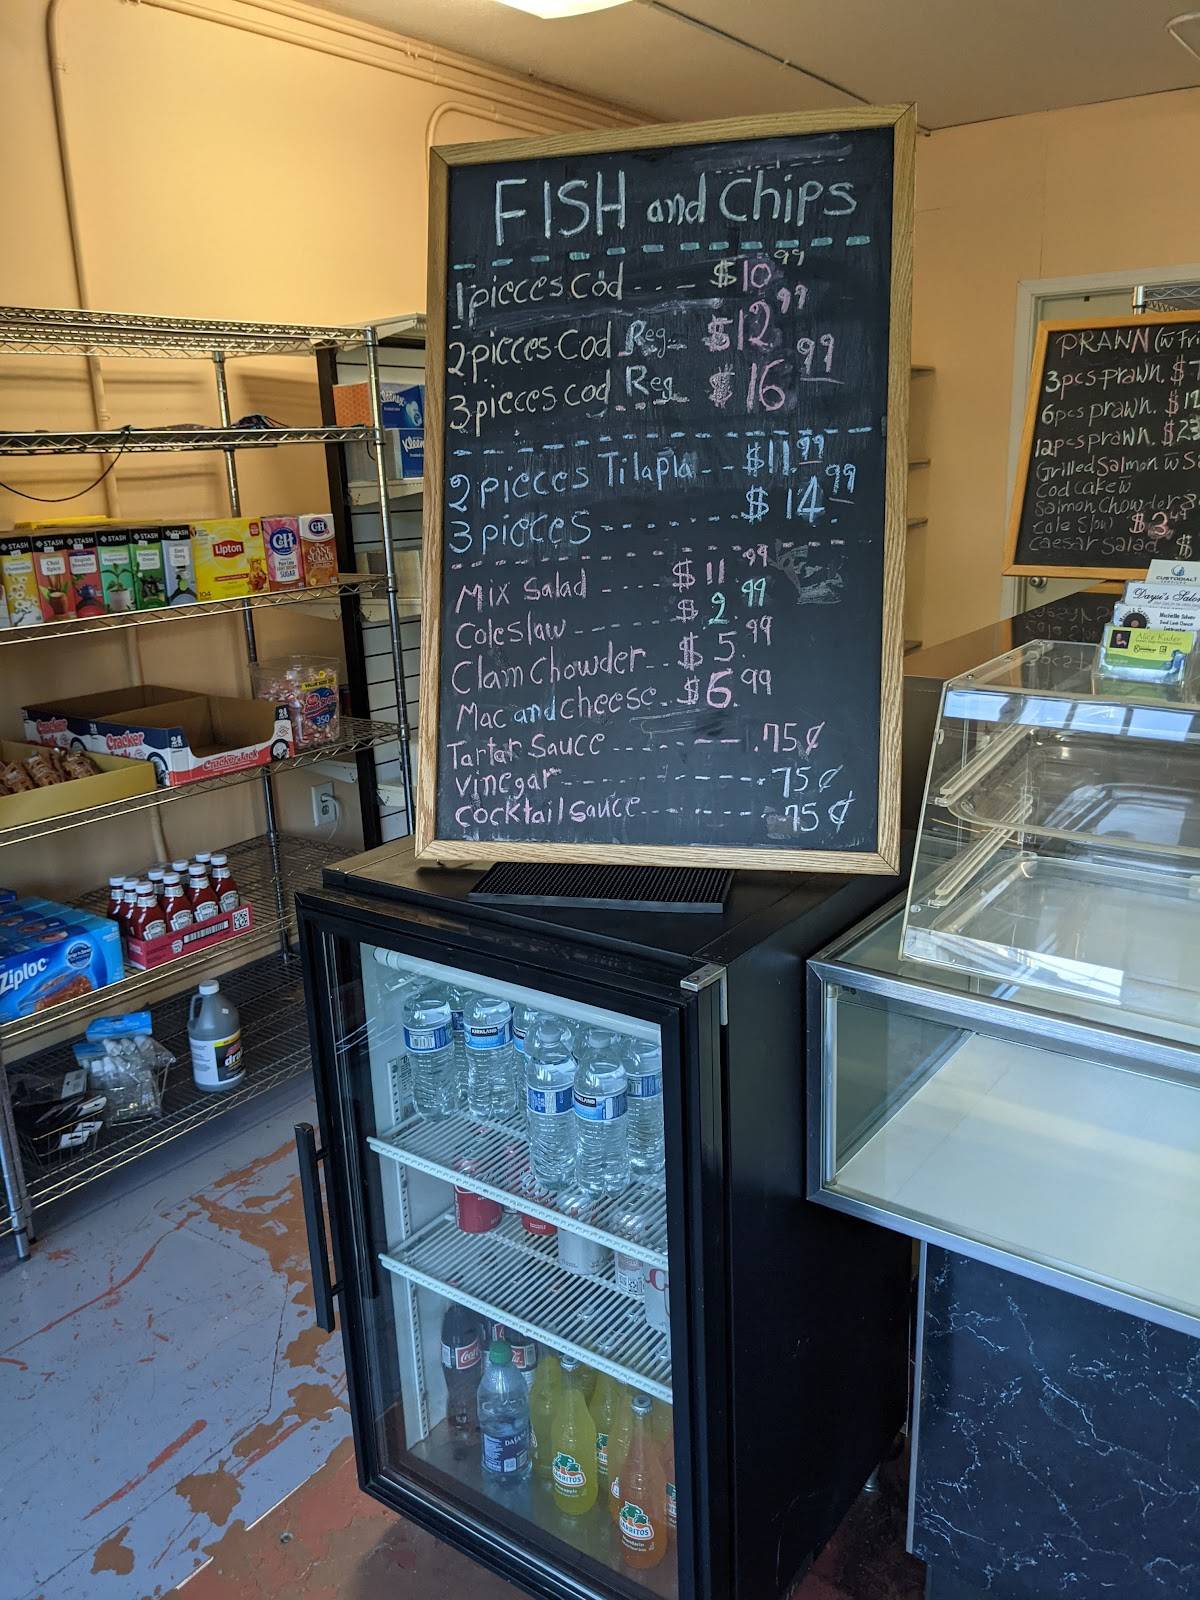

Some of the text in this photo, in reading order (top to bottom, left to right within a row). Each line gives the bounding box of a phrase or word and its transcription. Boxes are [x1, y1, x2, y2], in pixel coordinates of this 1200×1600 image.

[495, 169, 858, 247] FISH and Chips
[570, 261, 624, 301] Cod
[557, 320, 612, 360] Cod
[1056, 327, 1150, 358] PRAWN
[1096, 455, 1158, 477] Salmon
[480, 465, 590, 510] pieces
[8, 542, 29, 550] STASH
[140, 532, 159, 540] STASH
[215, 545, 242, 555] Lipton
[482, 510, 592, 555] pieces
[455, 578, 511, 614] Mix
[523, 568, 586, 600] Salad
[451, 655, 523, 694] Clam
[530, 641, 646, 685] Chowder
[314, 714, 330, 724] 350
[456, 702, 507, 732] Mac
[513, 696, 556, 724] and
[560, 686, 657, 719] cheese
[106, 731, 145, 751] Cracker
[447, 737, 522, 769] Tartar
[0, 958, 47, 996] Ziploc
